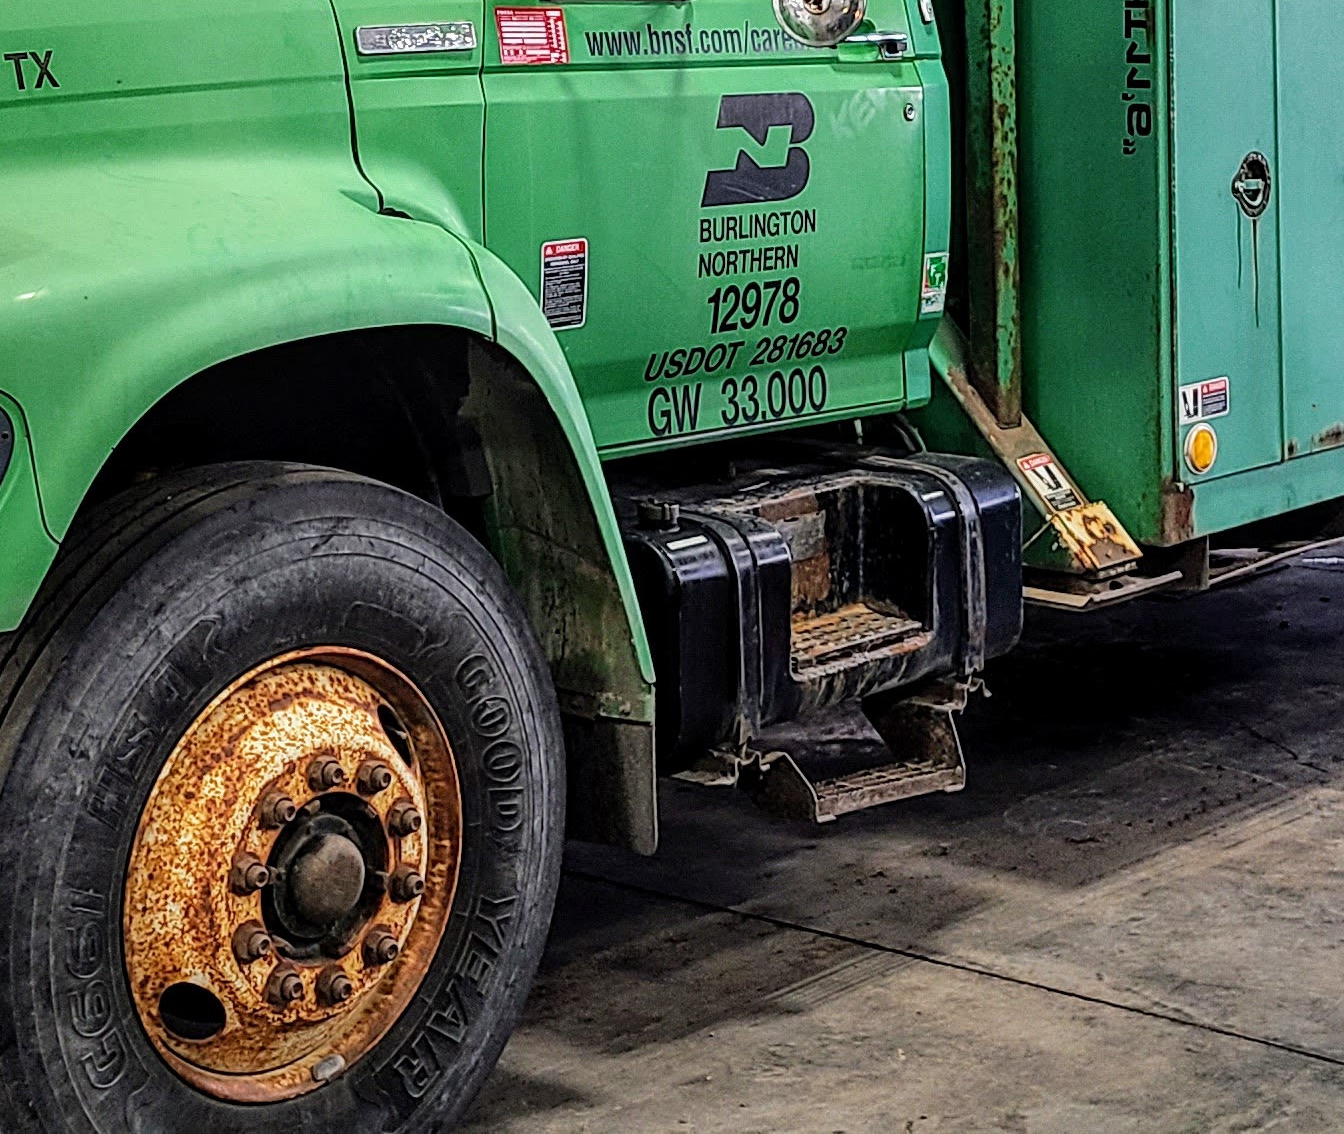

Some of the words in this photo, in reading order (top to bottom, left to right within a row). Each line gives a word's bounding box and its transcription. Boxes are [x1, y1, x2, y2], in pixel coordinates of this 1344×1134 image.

[585, 20, 805, 57] www.bnsf.com/care
[3, 49, 61, 92] TX
[699, 208, 817, 243] BURLINGTON
[697, 244, 799, 278] NORTHERN
[707, 276, 801, 335] 12978
[643, 341, 746, 382] USDOT
[748, 326, 848, 366] 281683
[647, 382, 703, 437] GW
